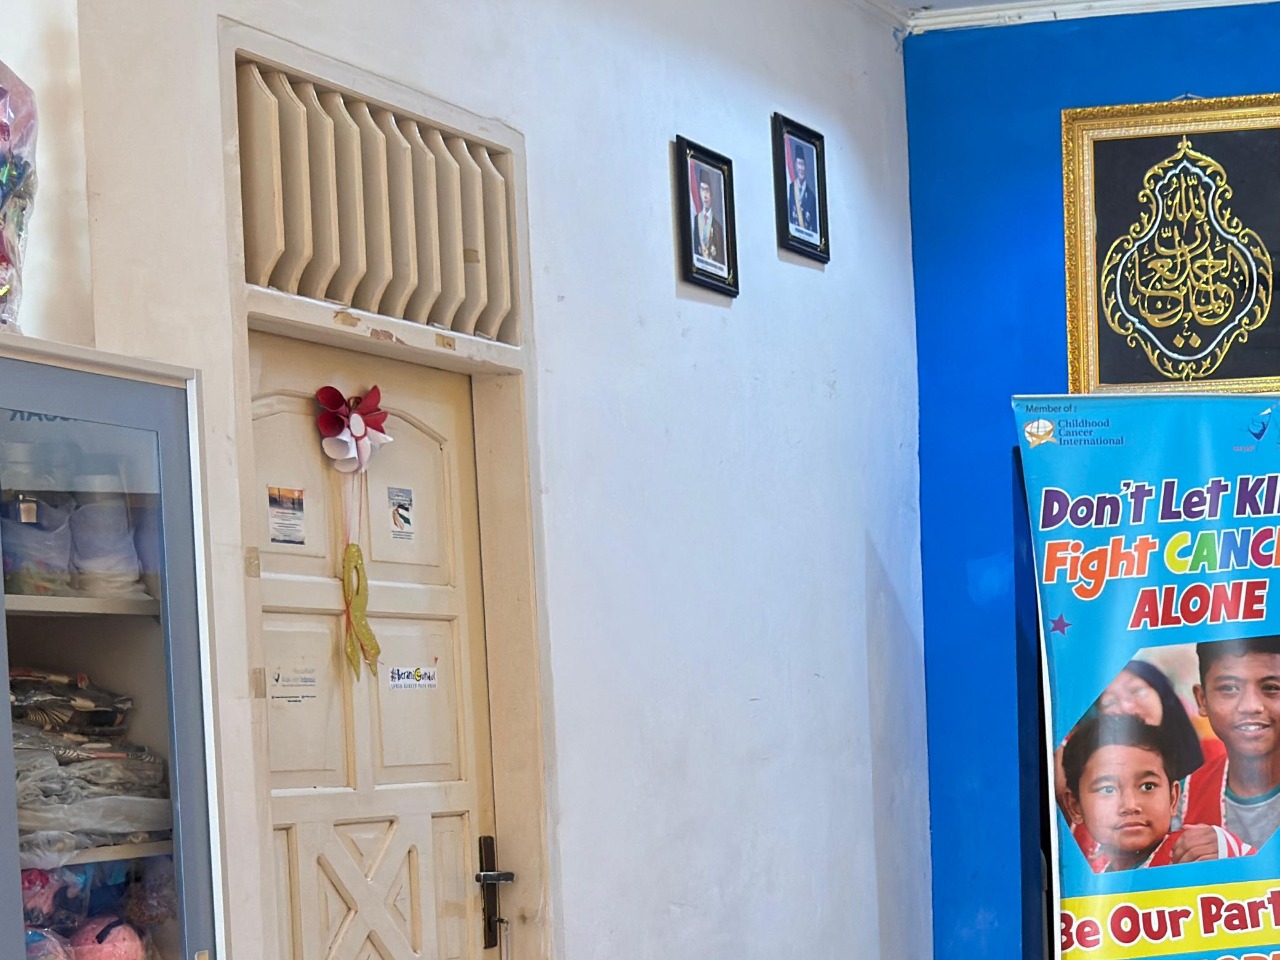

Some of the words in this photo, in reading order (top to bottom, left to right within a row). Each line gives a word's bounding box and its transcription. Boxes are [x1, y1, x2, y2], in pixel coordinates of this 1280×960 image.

[1026, 405, 1061, 413] Member
[1058, 419, 1109, 428] Childhood
[1060, 437, 1123, 445] International
[1041, 482, 1154, 529] Don't
[1160, 477, 1230, 522] Let
[1042, 534, 1156, 600] Fight
[1128, 580, 1268, 630] ALONE
[1109, 905, 1191, 945] Our
